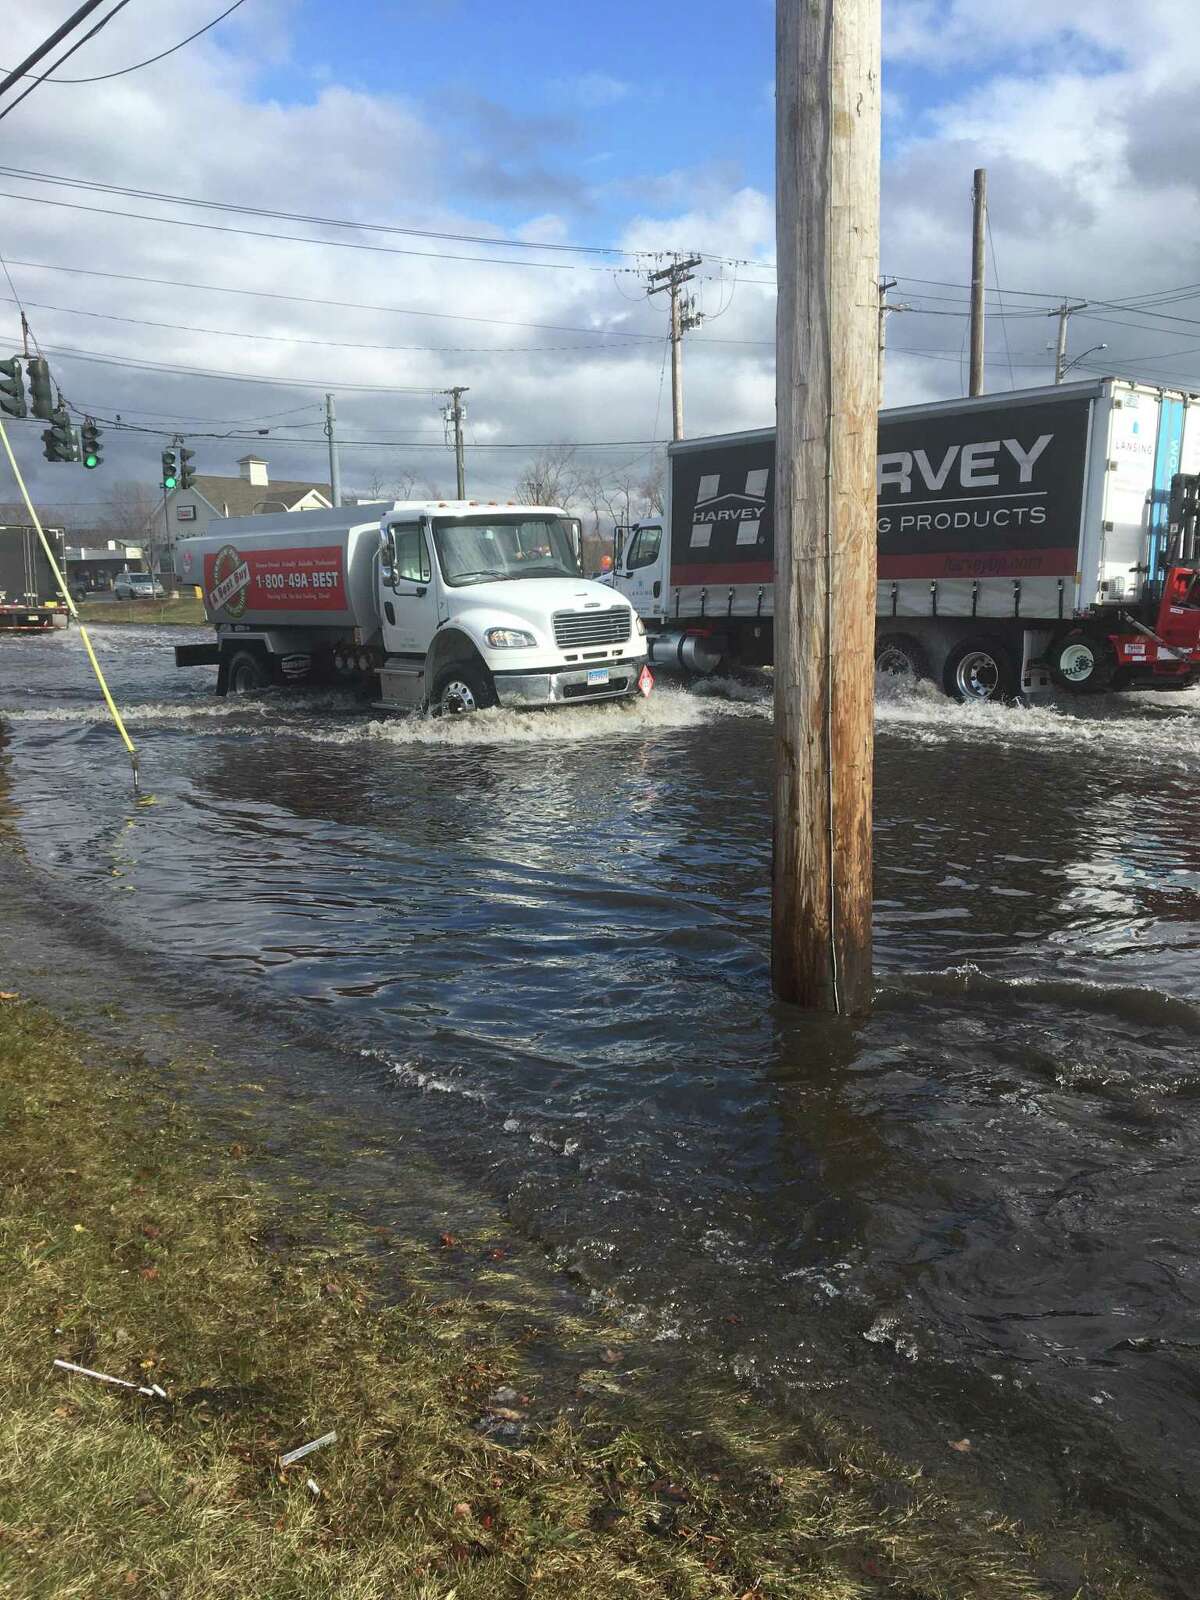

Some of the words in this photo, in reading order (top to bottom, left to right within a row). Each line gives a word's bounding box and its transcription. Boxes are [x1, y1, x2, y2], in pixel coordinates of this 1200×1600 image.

[1116, 440, 1153, 456] LANSING
[877, 434, 1054, 496] RVEY
[693, 506, 766, 523] HARVEY
[900, 507, 1047, 532] PRODUCTS
[256, 571, 338, 589] 1-800-49A-BEST
